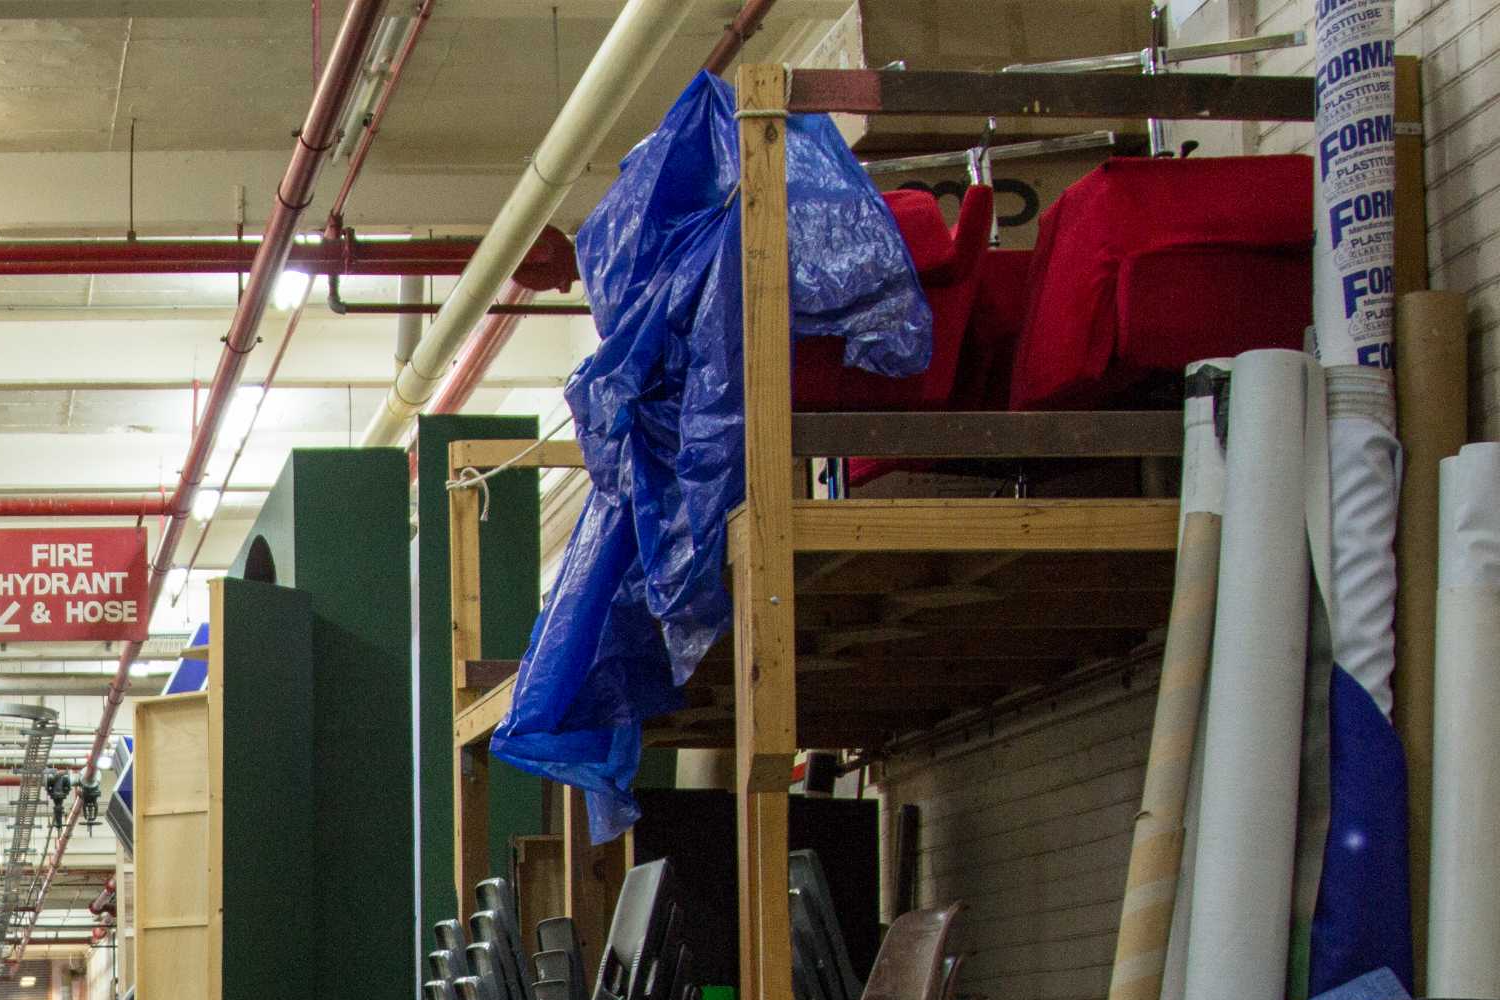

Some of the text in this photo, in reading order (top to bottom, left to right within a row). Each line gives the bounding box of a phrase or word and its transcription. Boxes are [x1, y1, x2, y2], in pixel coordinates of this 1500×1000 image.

[31, 543, 93, 567] FIRE
[31, 600, 137, 624] & HOSE
